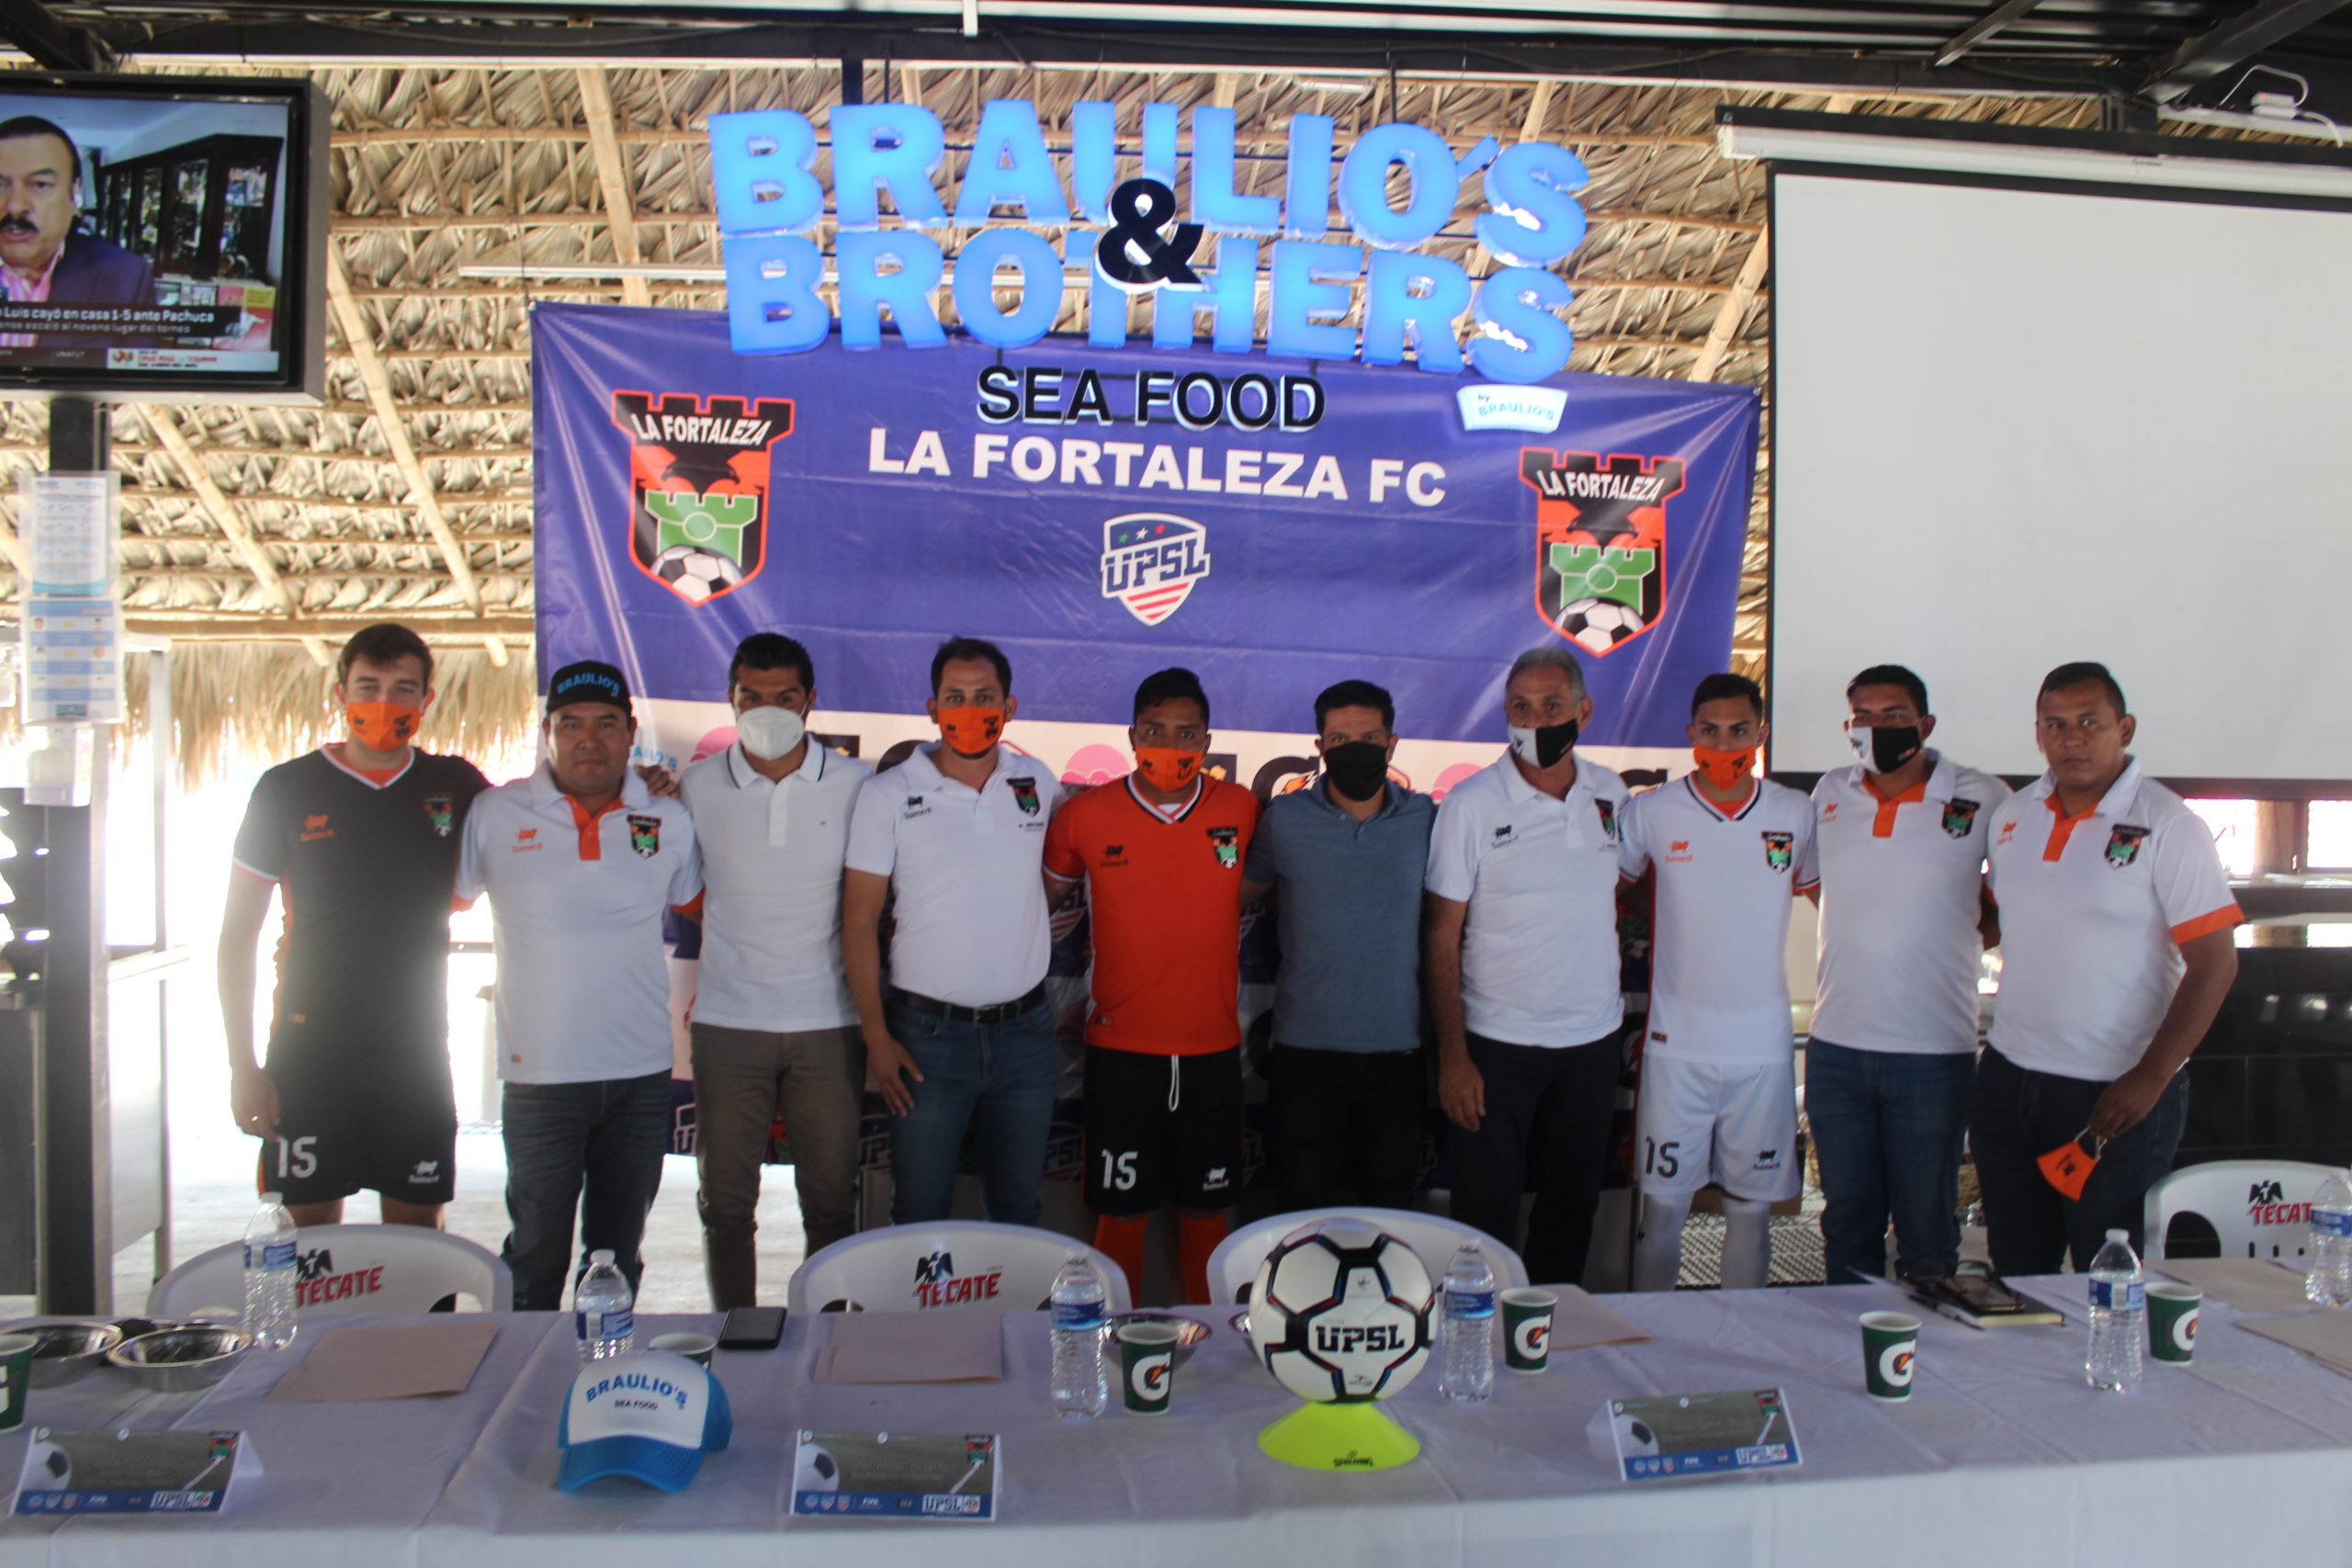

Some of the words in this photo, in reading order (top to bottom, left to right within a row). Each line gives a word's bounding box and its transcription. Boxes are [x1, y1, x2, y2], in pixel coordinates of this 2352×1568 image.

[1095, 178, 1204, 295] &
[4, 307, 29, 319] Luis
[62, 310, 79, 320] en
[111, 309, 132, 321] 1-5
[133, 310, 161, 321] ante
[162, 309, 215, 323] Pachuca
[977, 366, 1113, 426] SEA
[1135, 368, 1326, 432] FOOD
[1477, 402, 1555, 421] BRAULIO'S
[630, 412, 662, 441] LA
[662, 414, 773, 446] FORTALEZA
[868, 427, 952, 477] LA
[972, 434, 1349, 502] FORTALEZA
[1369, 457, 1447, 508] FC
[1536, 469, 1566, 496] LA
[1564, 471, 1666, 502] FORTALEZA
[1103, 536, 1207, 594] UPSL
[557, 672, 621, 695] BRAULIO'S
[277, 1135, 318, 1179] 15
[1102, 1148, 1138, 1191] 15
[1645, 1135, 1680, 1179] 15
[2247, 1201, 2313, 1226] TECAT
[294, 1264, 385, 1309] TECATE
[912, 1270, 1003, 1309] TECATE
[1315, 1324, 1406, 1354] UPSL
[1513, 1313, 1553, 1359] G
[1131, 1350, 1172, 1401] G
[1879, 1337, 1917, 1387] G
[585, 1373, 689, 1406] BRAULIO'S
